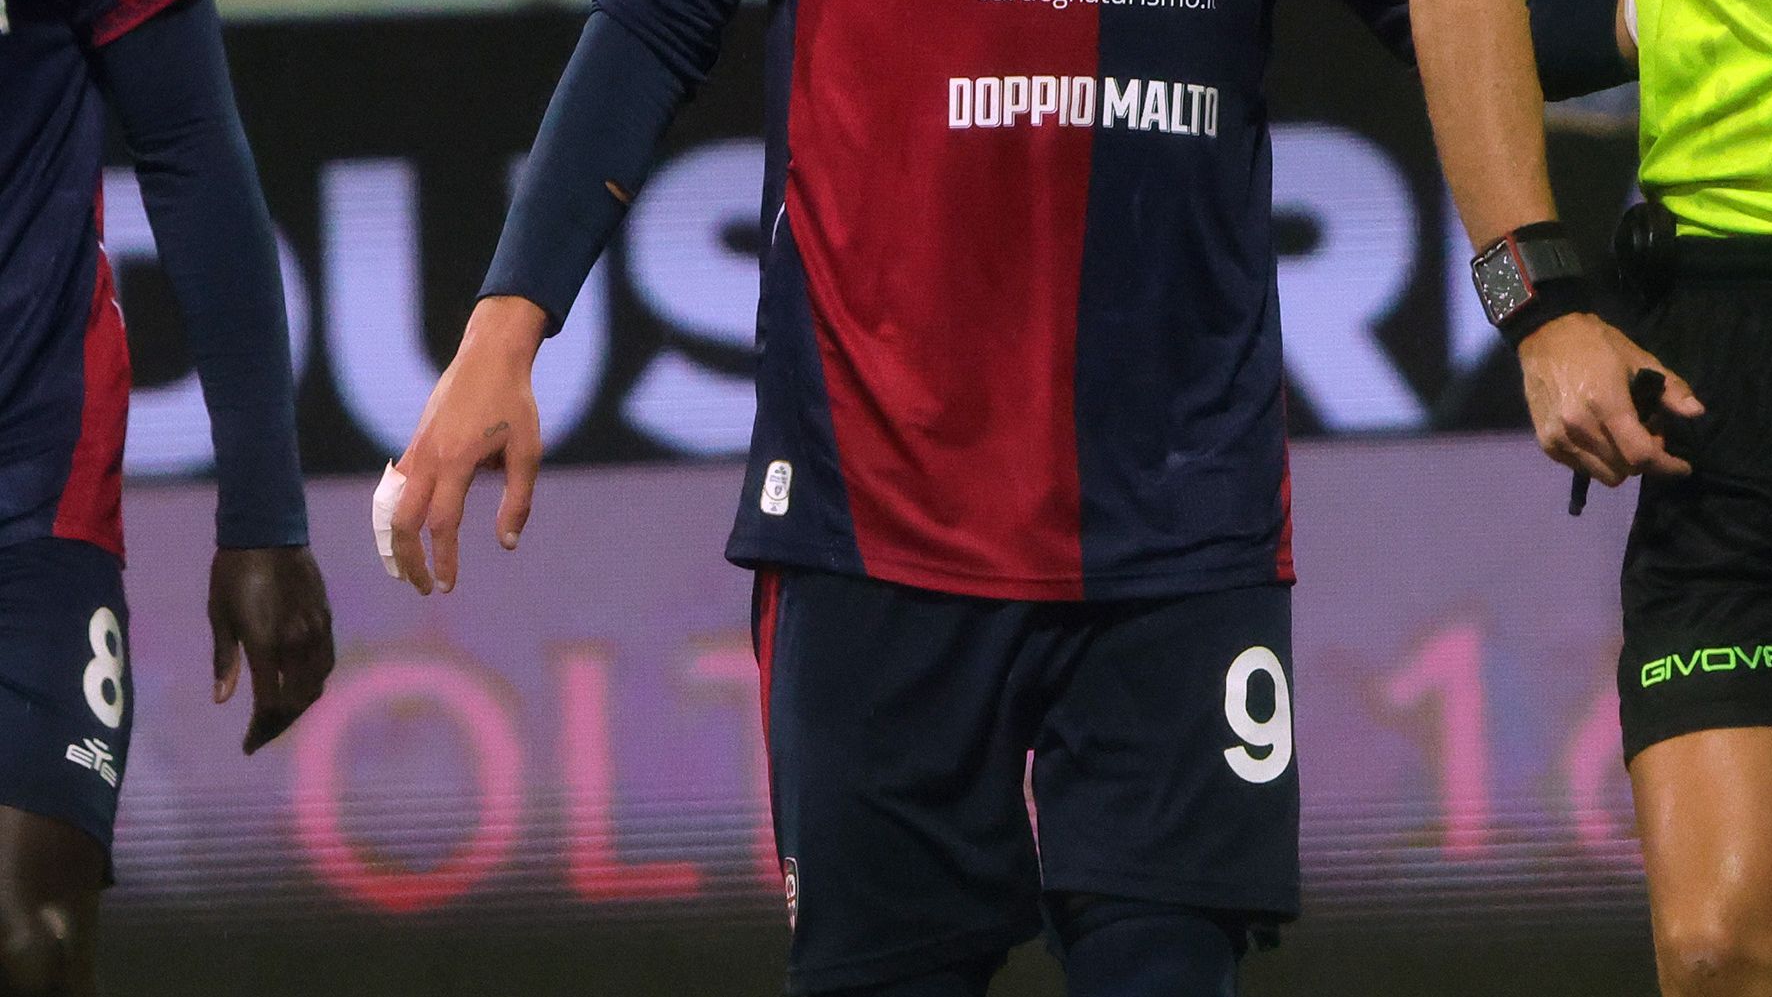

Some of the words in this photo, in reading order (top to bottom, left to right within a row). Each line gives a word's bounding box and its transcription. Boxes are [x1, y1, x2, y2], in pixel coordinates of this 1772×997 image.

[949, 76, 1097, 129] DOPPIO
[1103, 77, 1219, 138] MALTO
[83, 607, 124, 728] 8
[1224, 646, 1292, 784] 9
